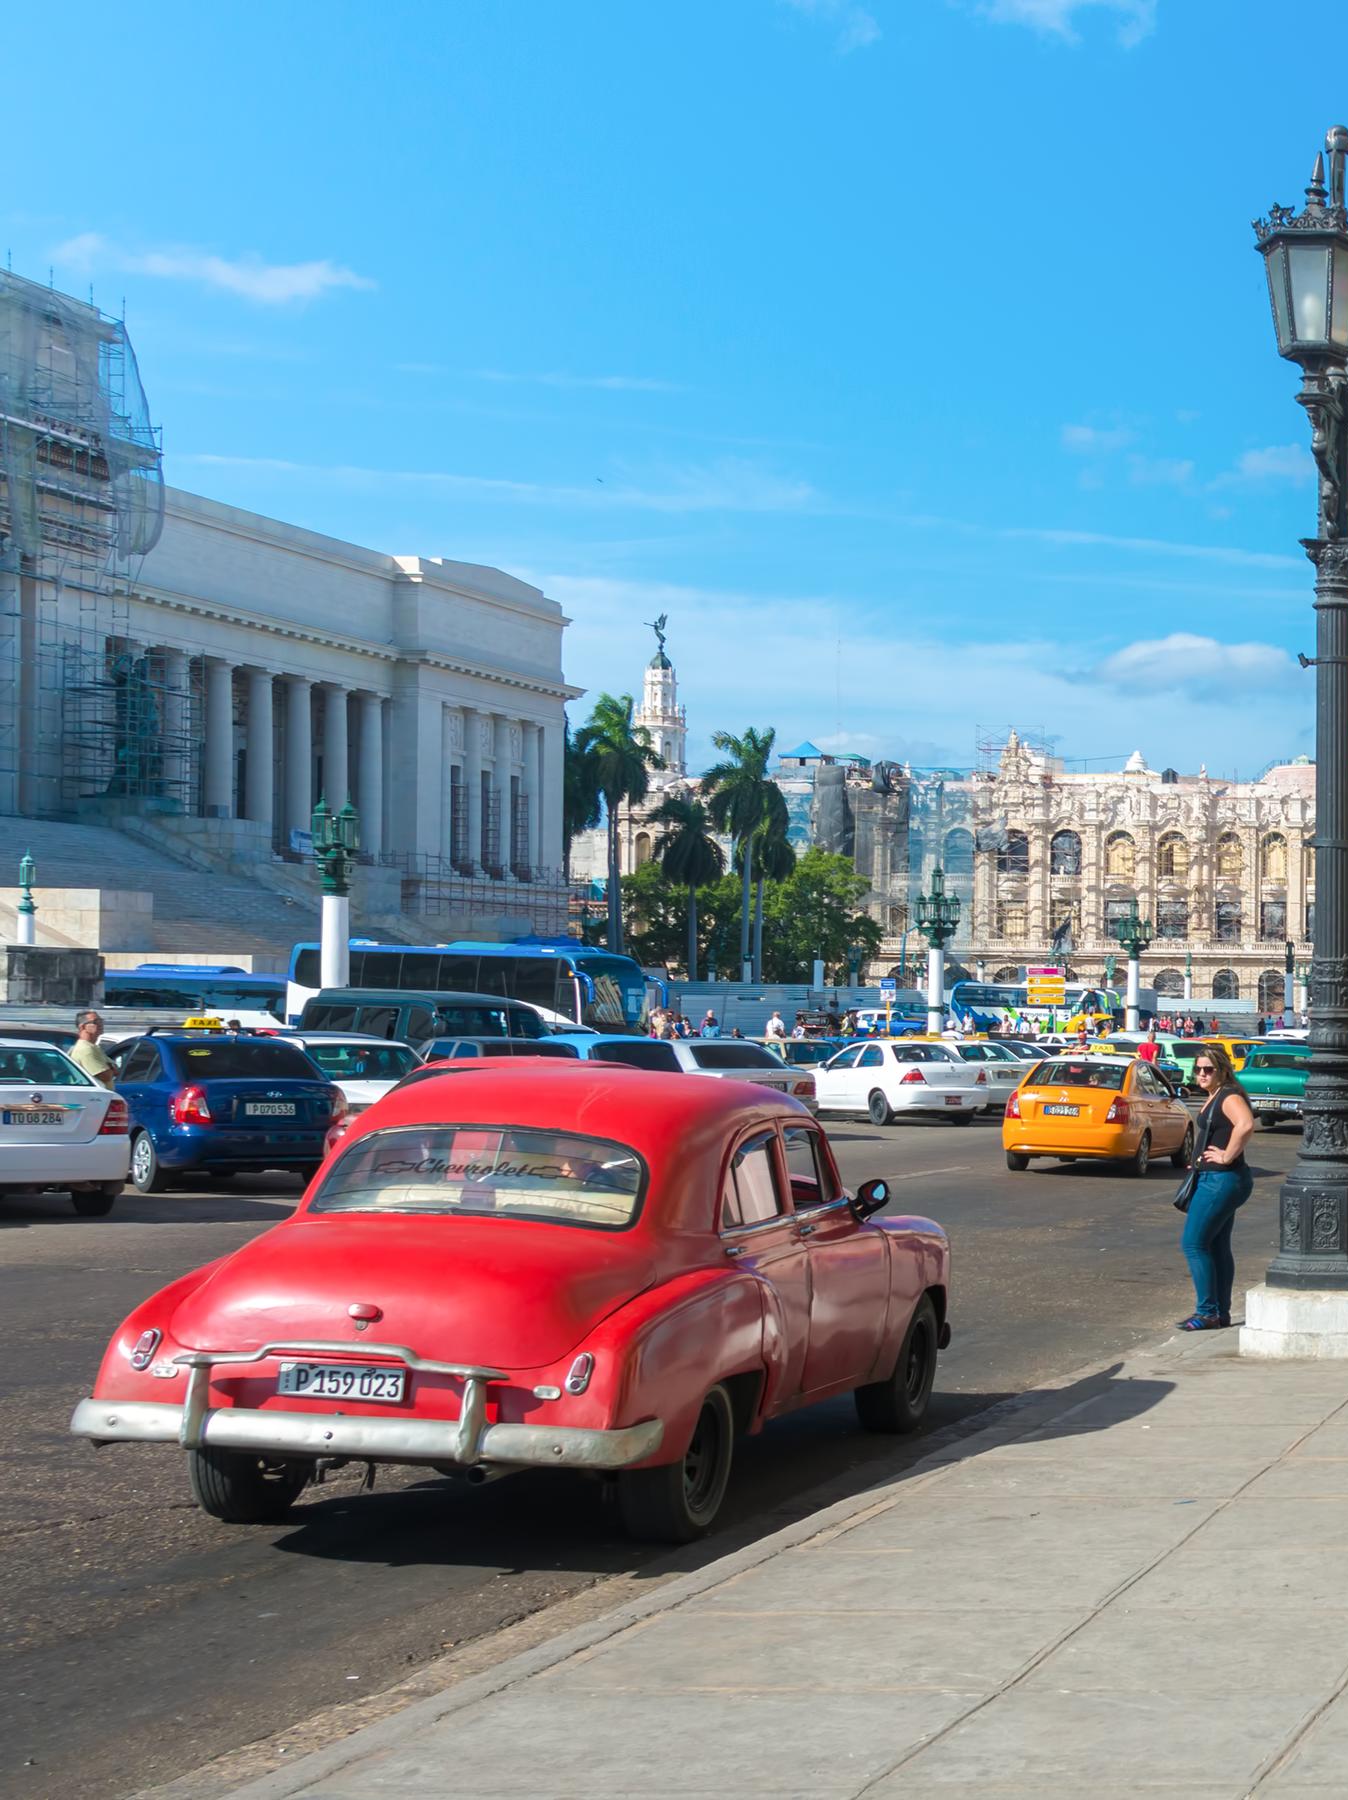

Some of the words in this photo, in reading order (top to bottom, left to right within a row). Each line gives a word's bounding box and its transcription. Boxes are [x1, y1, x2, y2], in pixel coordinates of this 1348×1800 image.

[1094, 1044, 1113, 1052] TAXI
[413, 1157, 530, 1178] Chevrolet
[313, 1369, 355, 1395] 159
[360, 1372, 400, 1398] 023
